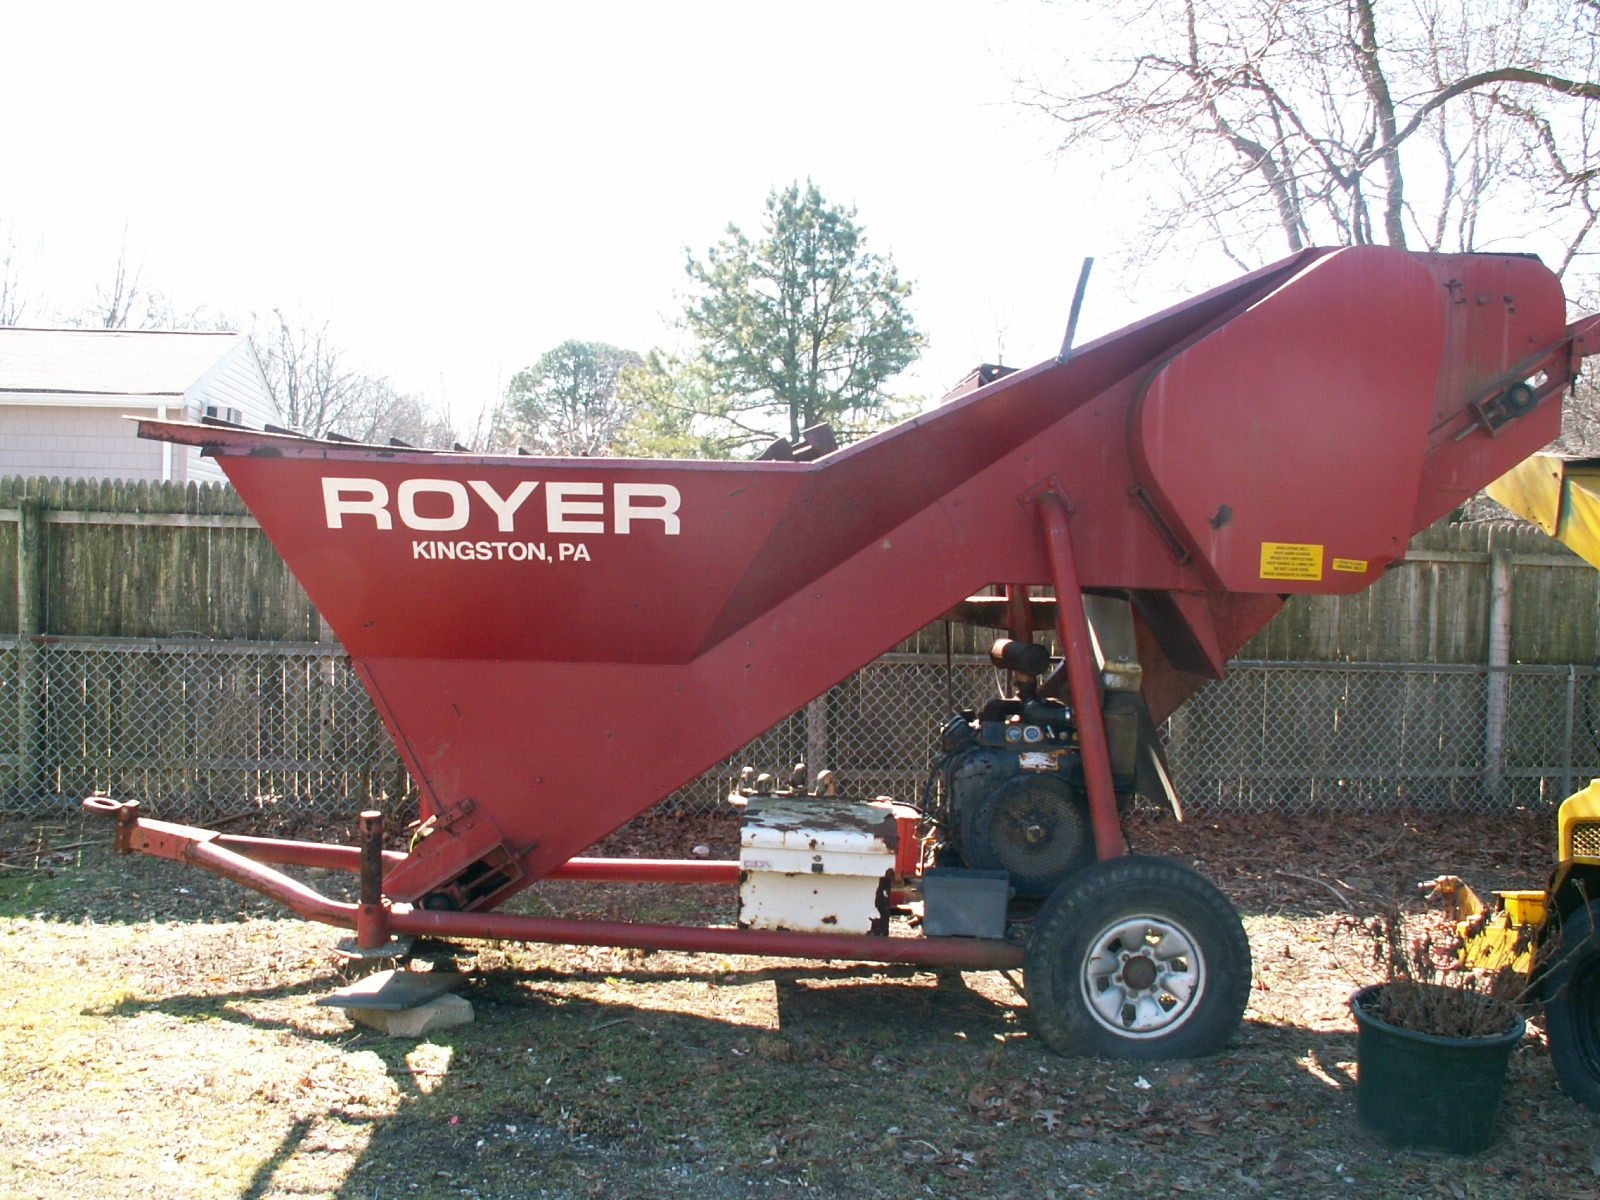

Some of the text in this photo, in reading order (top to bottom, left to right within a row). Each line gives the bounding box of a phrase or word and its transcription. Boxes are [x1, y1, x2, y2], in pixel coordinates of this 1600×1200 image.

[321, 477, 681, 535] ROYER
[412, 541, 591, 563] KINGSTON, PA
